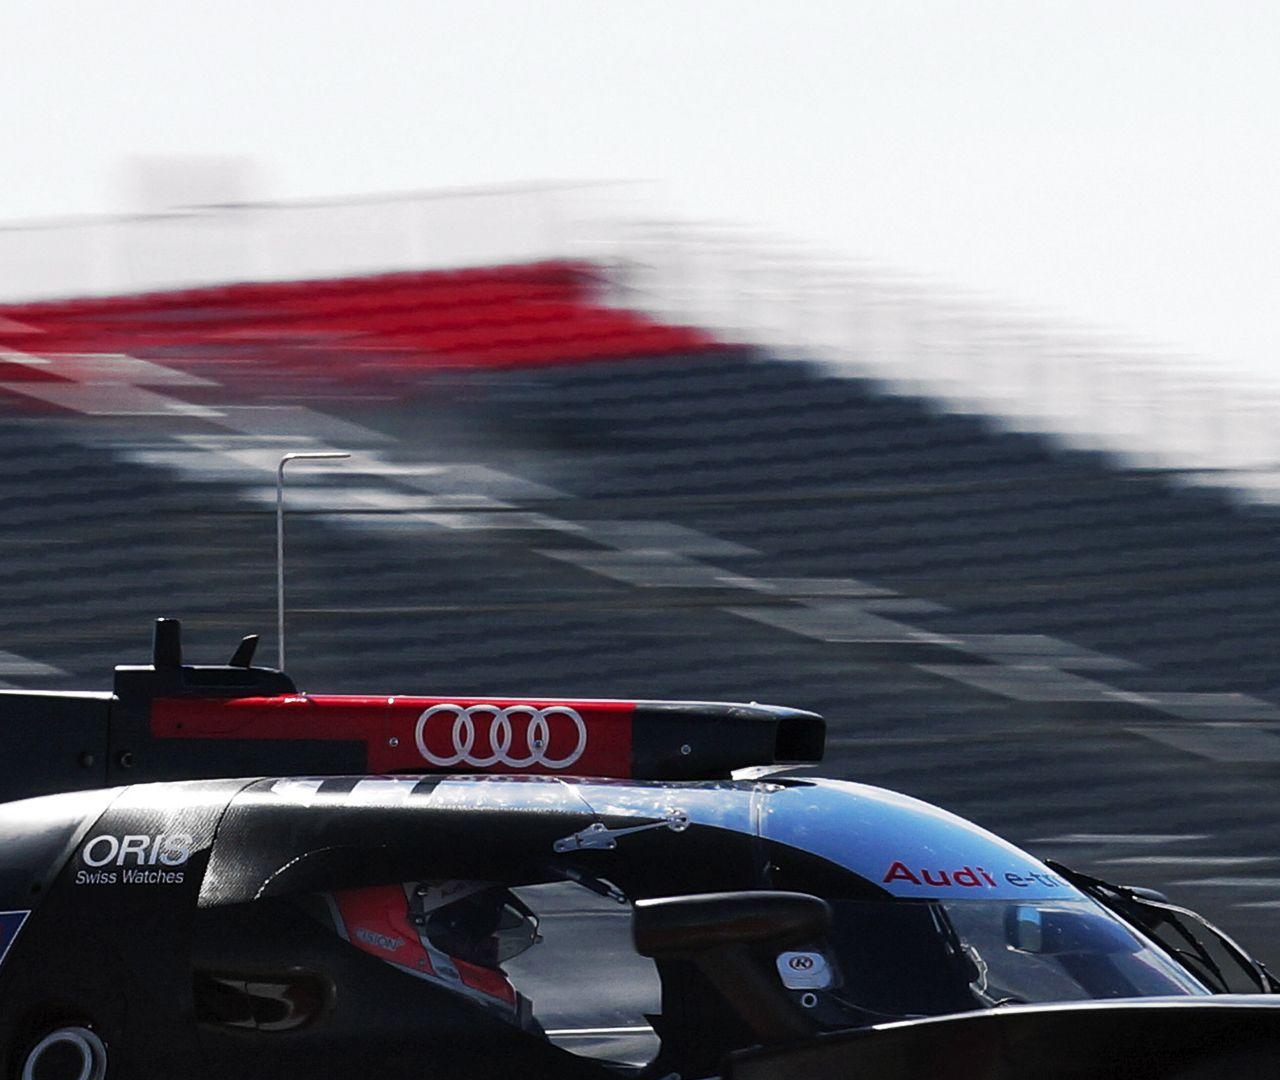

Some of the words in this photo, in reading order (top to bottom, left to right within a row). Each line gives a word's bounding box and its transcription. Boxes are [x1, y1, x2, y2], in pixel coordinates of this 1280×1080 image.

[83, 834, 193, 867] ORIS
[75, 870, 118, 884] Swiss
[122, 869, 185, 884] Watches
[883, 860, 998, 888] Audi
